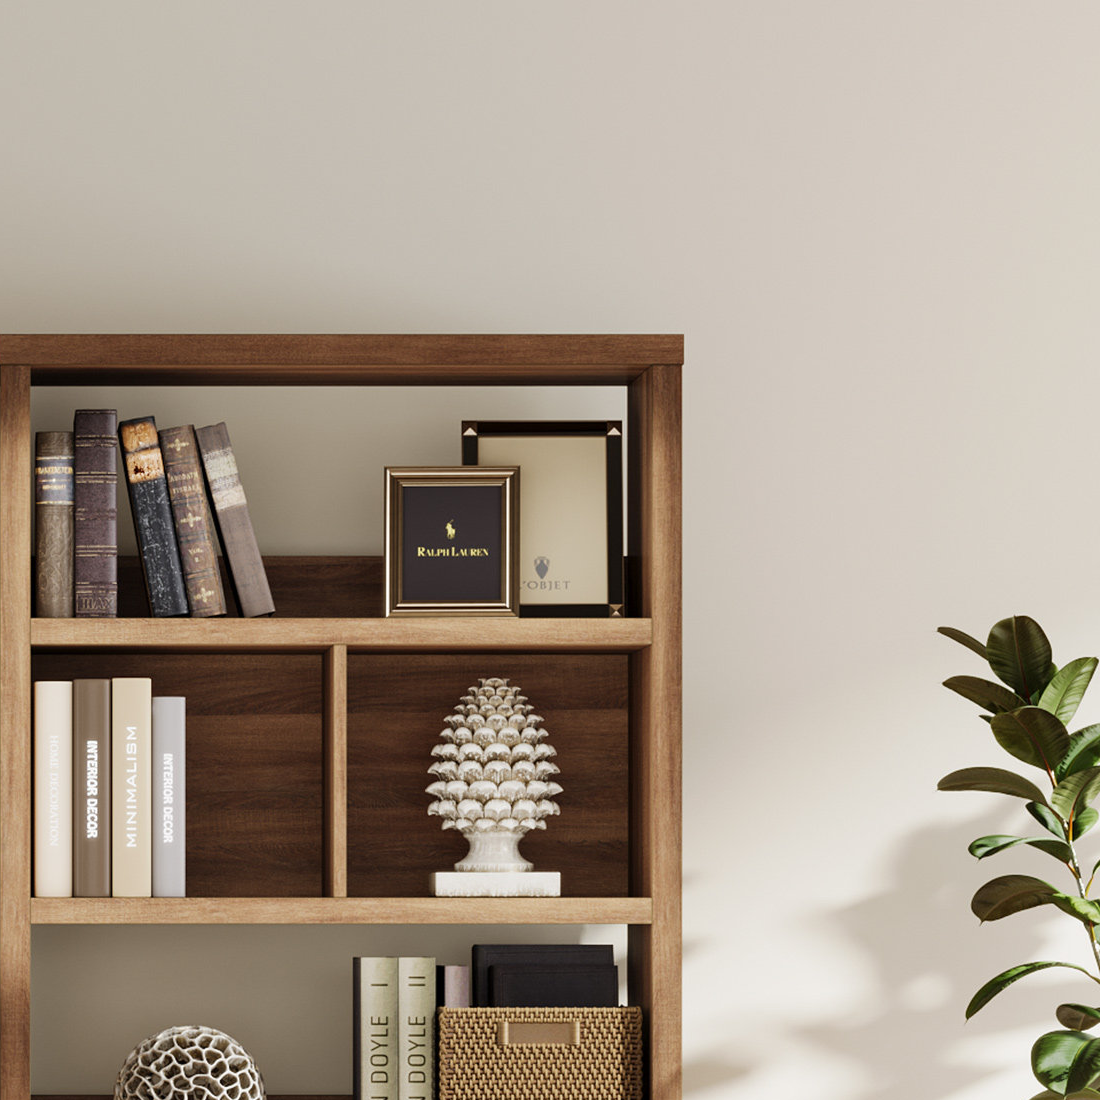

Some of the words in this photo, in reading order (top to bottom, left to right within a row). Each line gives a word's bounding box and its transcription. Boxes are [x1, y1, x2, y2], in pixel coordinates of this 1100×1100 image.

[417, 546, 450, 557] RALPH
[451, 546, 489, 557] LAUREN
[520, 581, 571, 590] 'OBJET
[86, 740, 98, 796] INTERIOR
[126, 726, 137, 848] MINIMALISM
[163, 753, 173, 804] INTERIOR
[86, 798, 98, 839] DECOR
[163, 806, 173, 843] DECOR
[370, 1015, 389, 1084] DOYLE
[407, 1015, 426, 1084] DOYLE
